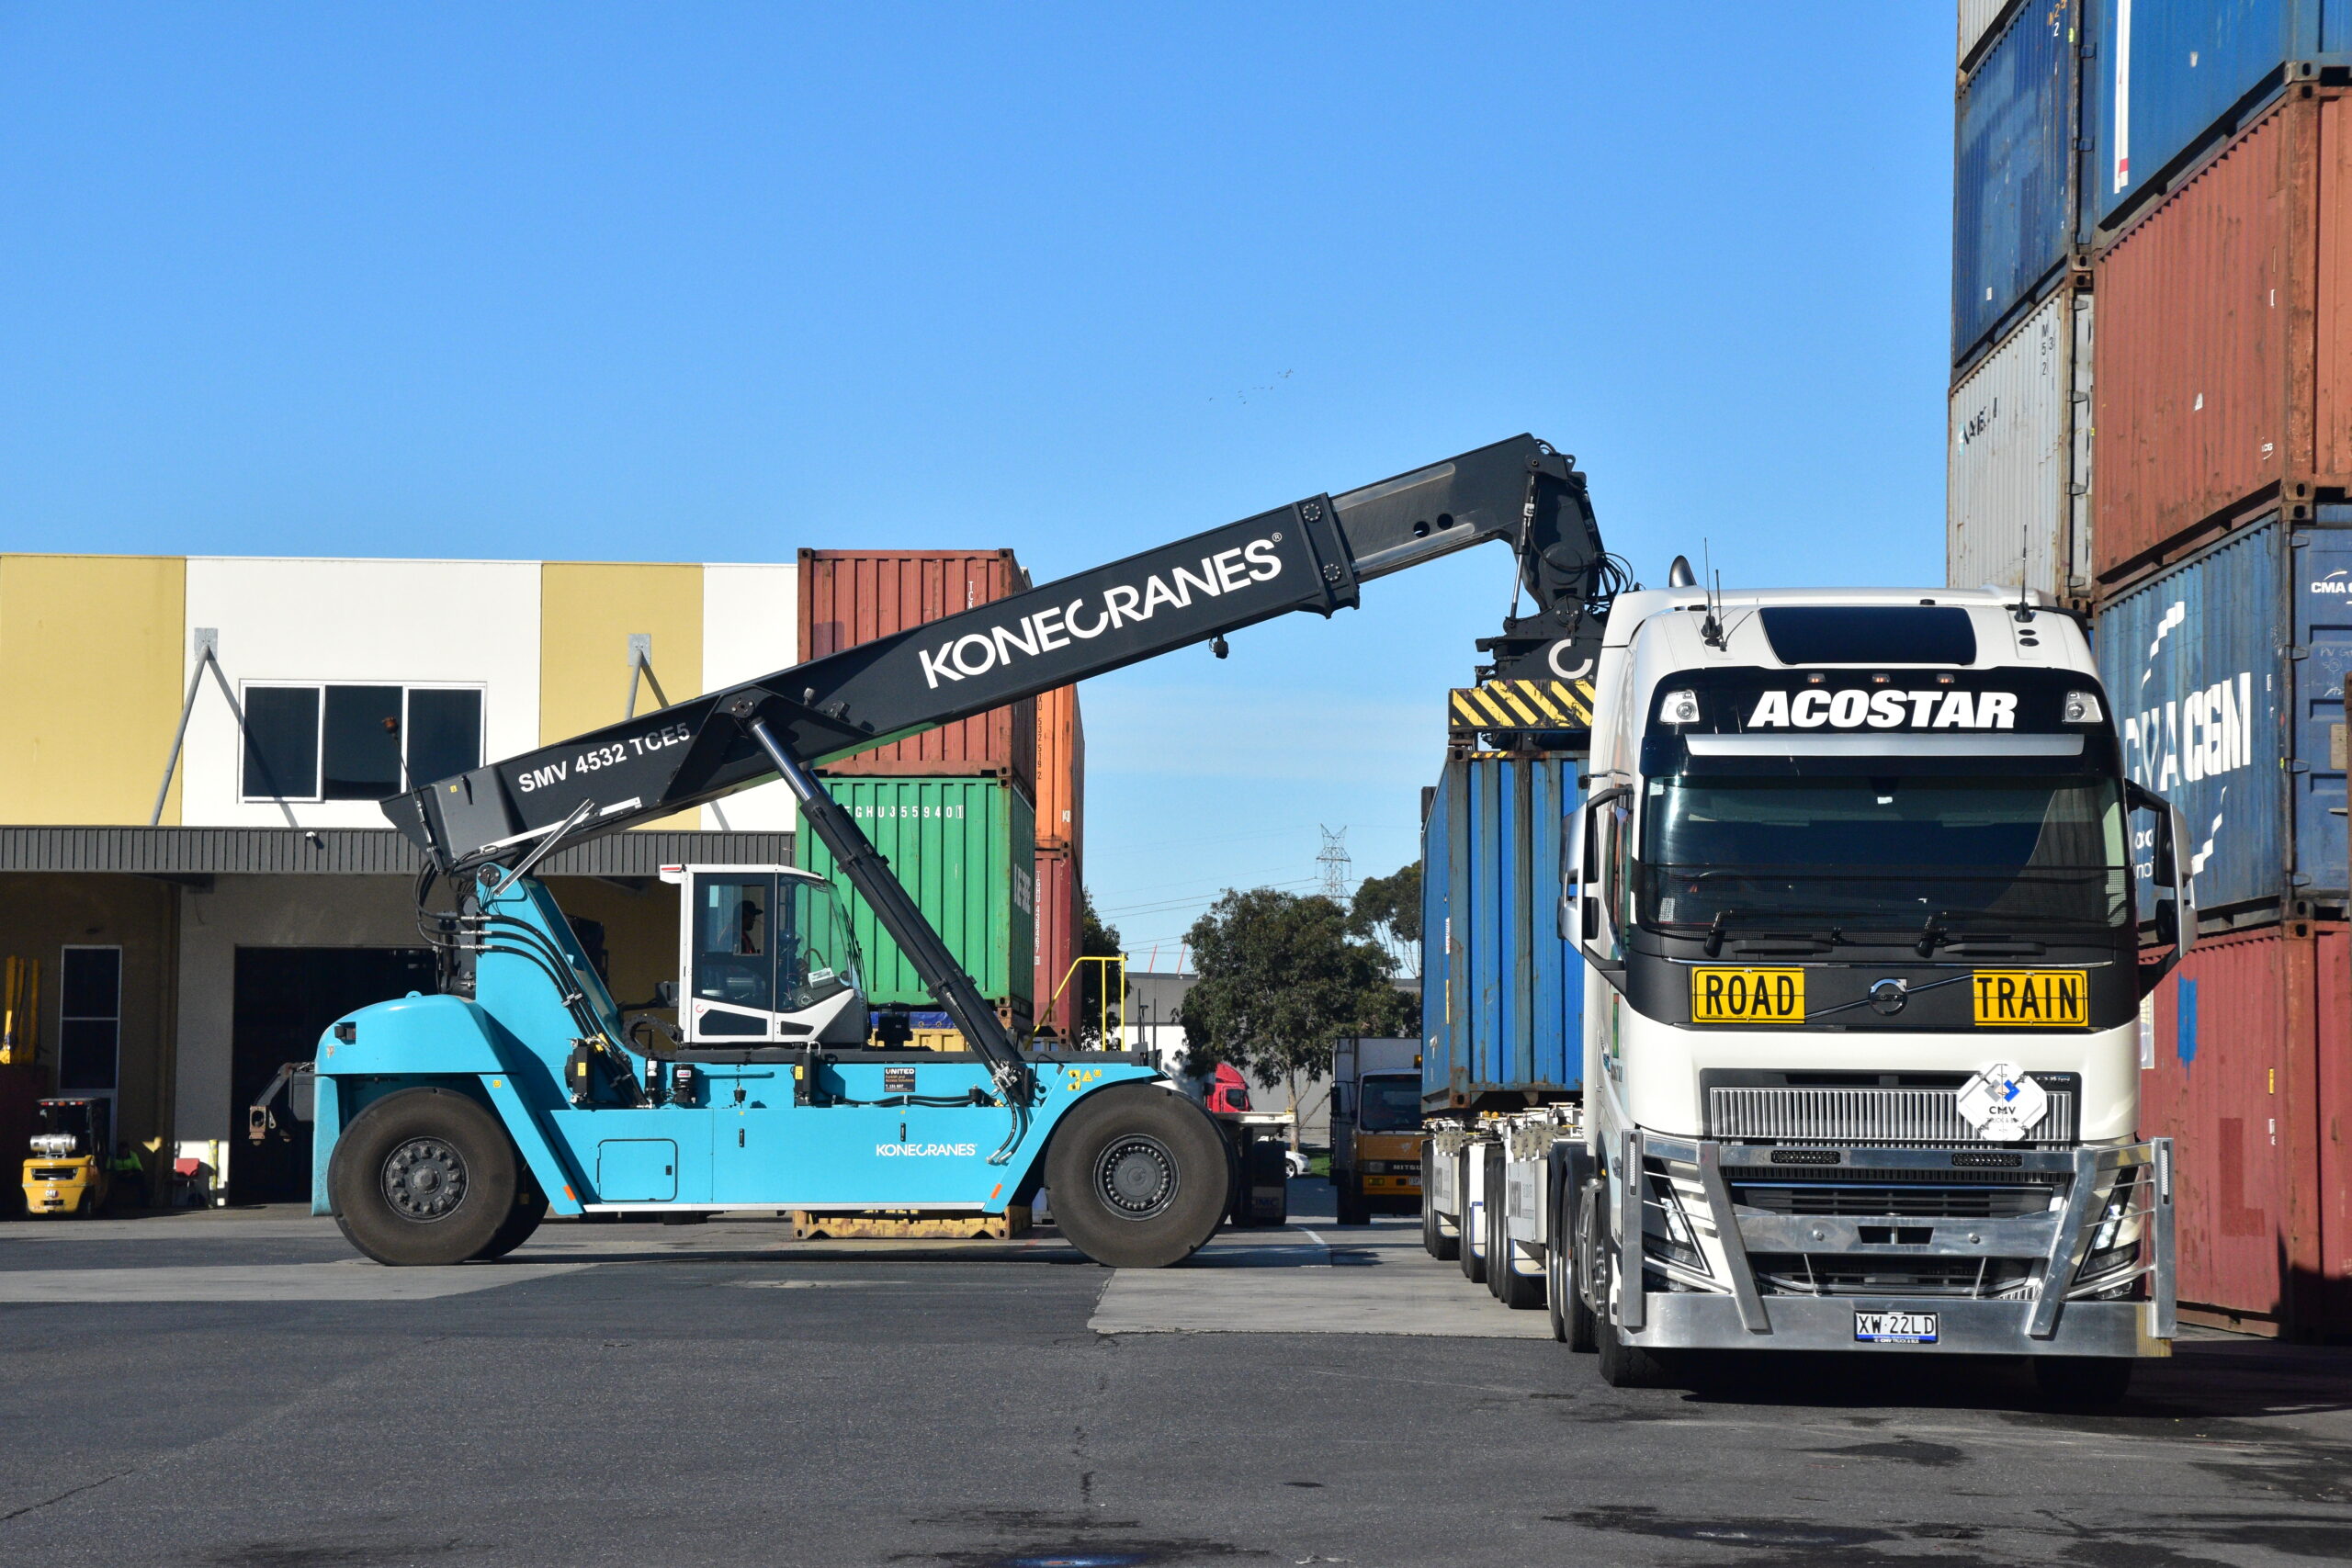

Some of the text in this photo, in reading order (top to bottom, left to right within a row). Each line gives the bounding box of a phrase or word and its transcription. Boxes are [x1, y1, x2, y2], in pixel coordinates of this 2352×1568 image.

[2311, 581, 2346, 593] CMA
[919, 538, 1283, 689] KONECRANES
[1747, 689, 2018, 728] ACOSTAR
[2184, 671, 2251, 783] CGM
[518, 722, 691, 793] SMV 4532 TCE5
[1706, 975, 1795, 1016] ROAD
[1977, 977, 2078, 1019] TRAIN
[1989, 1106, 2016, 1114] CMV
[876, 1143, 976, 1156] KONECRANES
